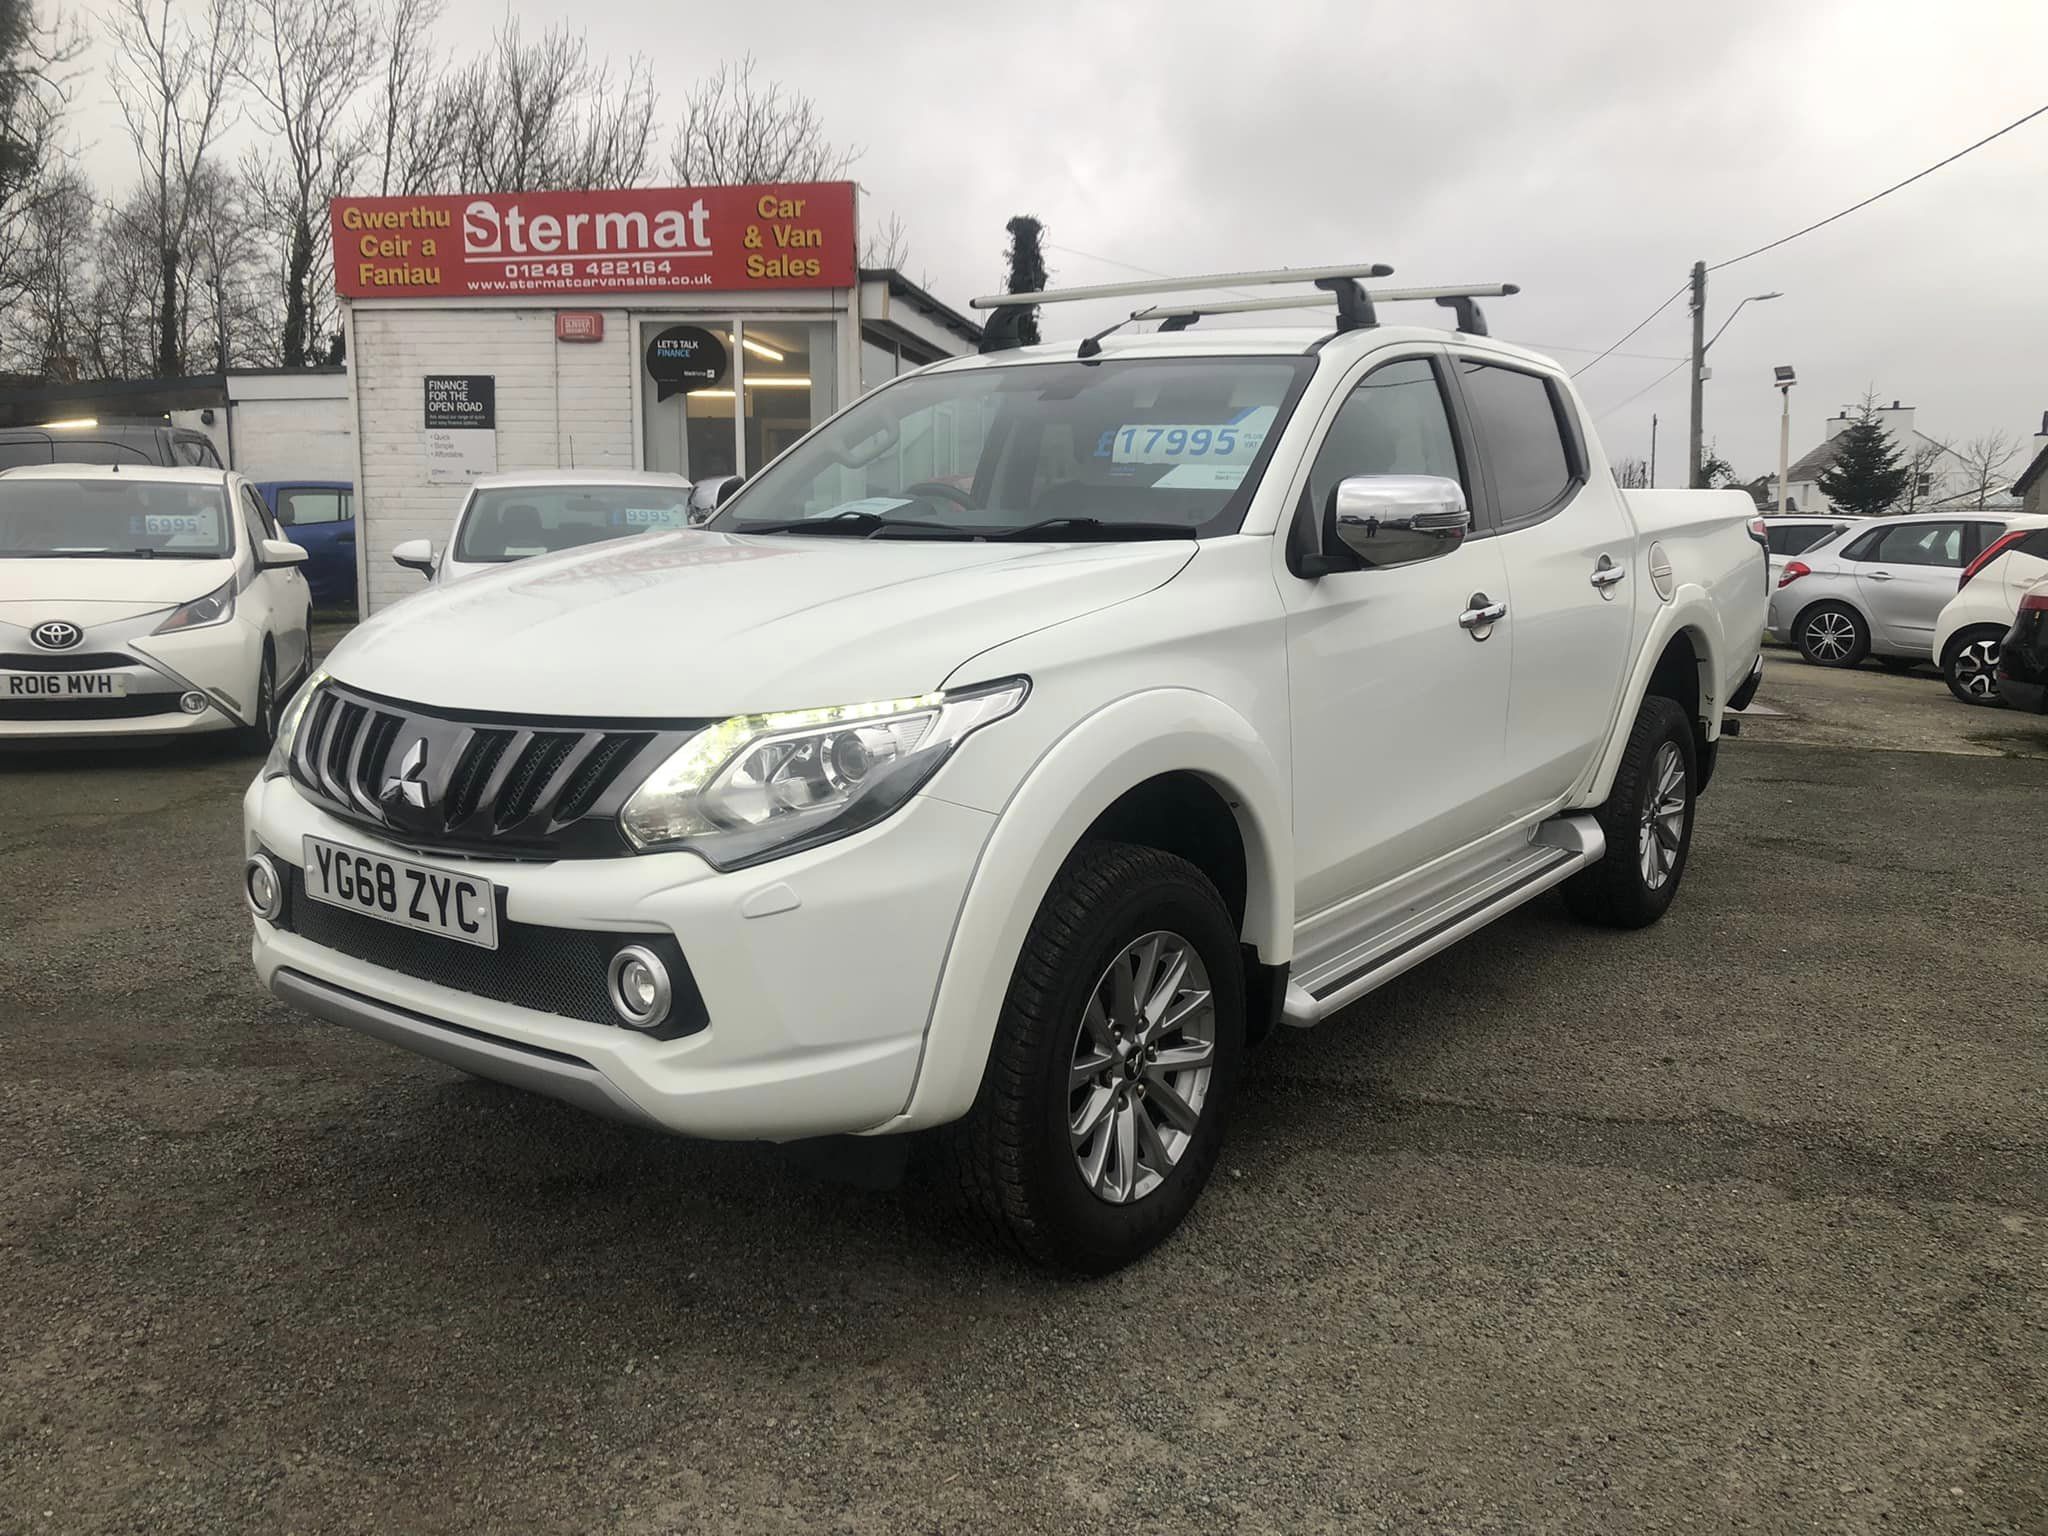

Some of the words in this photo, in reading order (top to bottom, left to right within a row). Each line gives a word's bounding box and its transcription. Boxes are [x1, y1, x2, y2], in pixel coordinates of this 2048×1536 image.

[758, 194, 806, 219] Car
[343, 206, 450, 229] Gwerthu
[463, 195, 712, 253] Stermat
[359, 234, 412, 257] Ceir
[421, 238, 437, 257] a
[743, 225, 763, 248] &
[772, 223, 823, 248] Van
[359, 263, 441, 286] Faniau
[505, 263, 574, 279] 01248
[586, 260, 672, 277] 422164
[746, 254, 821, 279] Sales
[467, 274, 712, 291] www.stermatcarvansales.co.uk
[657, 340, 679, 349] LET'S
[681, 340, 699, 349] TALK
[657, 349, 690, 357] FINANCE
[429, 380, 469, 390] FINANCE
[429, 391, 447, 401] FOR
[450, 391, 469, 401] THE
[429, 402, 454, 412] OPEN
[457, 402, 483, 412] ROAD
[9, 675, 61, 695] RO16
[67, 675, 113, 694] MVH
[315, 845, 398, 913] YG68
[405, 868, 480, 935] ZYC
